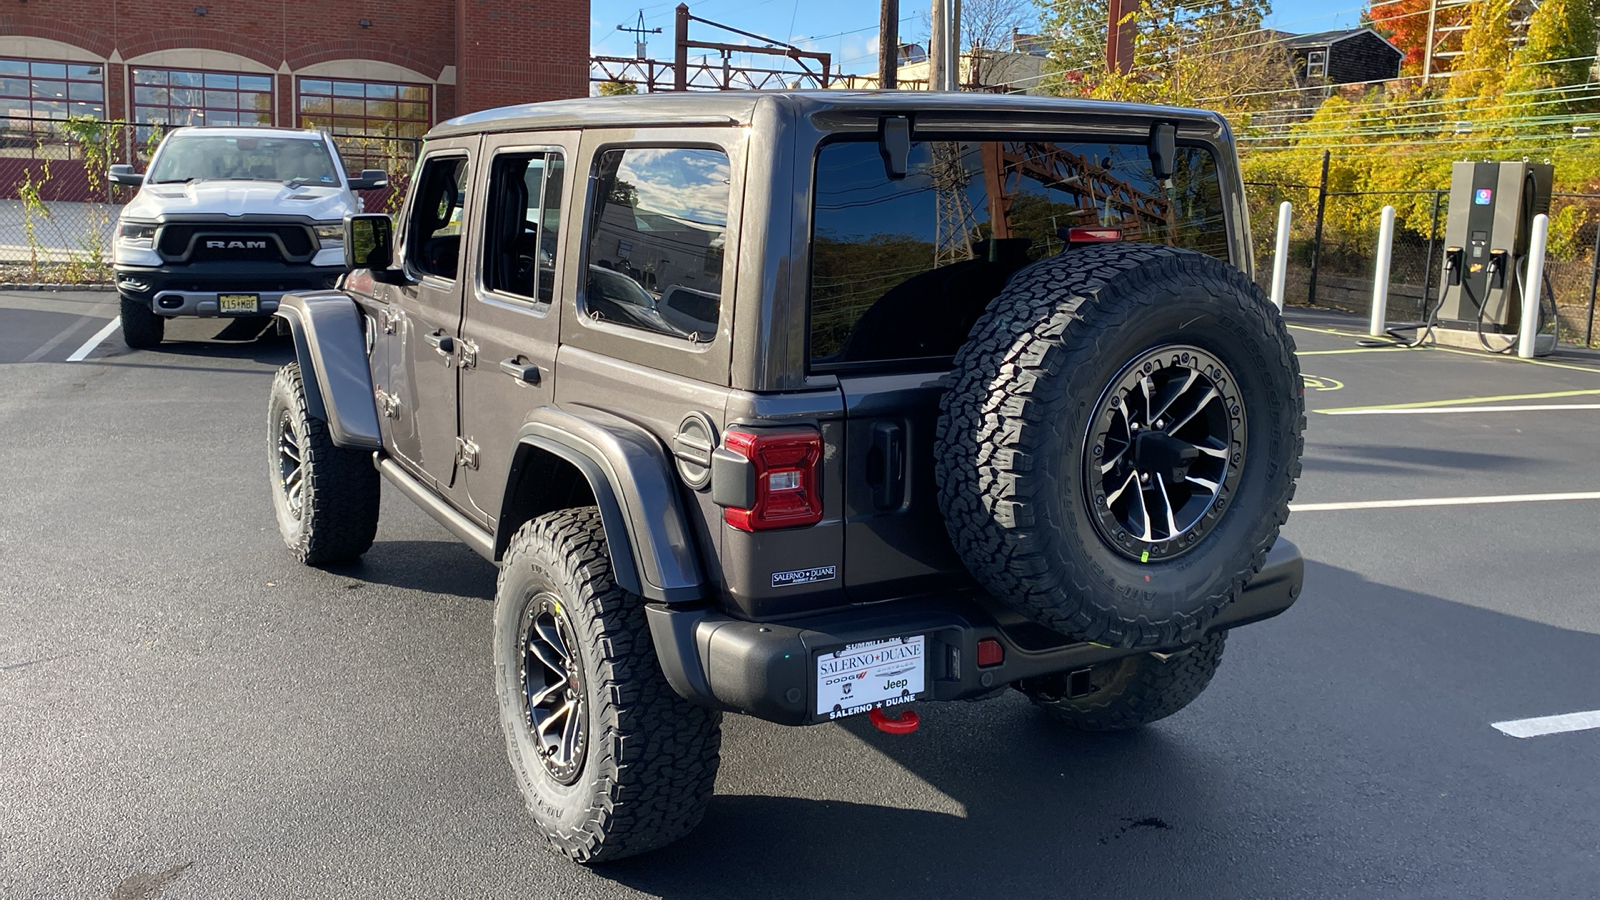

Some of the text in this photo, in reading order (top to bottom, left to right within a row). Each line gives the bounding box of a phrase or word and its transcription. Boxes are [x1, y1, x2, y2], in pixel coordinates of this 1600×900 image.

[774, 571, 805, 582] SALERNO
[810, 567, 834, 577] DUANE
[820, 643, 921, 675] SALERNO DUANE
[883, 679, 908, 690] Jeep
[829, 694, 916, 720] SALERNO DUANE
